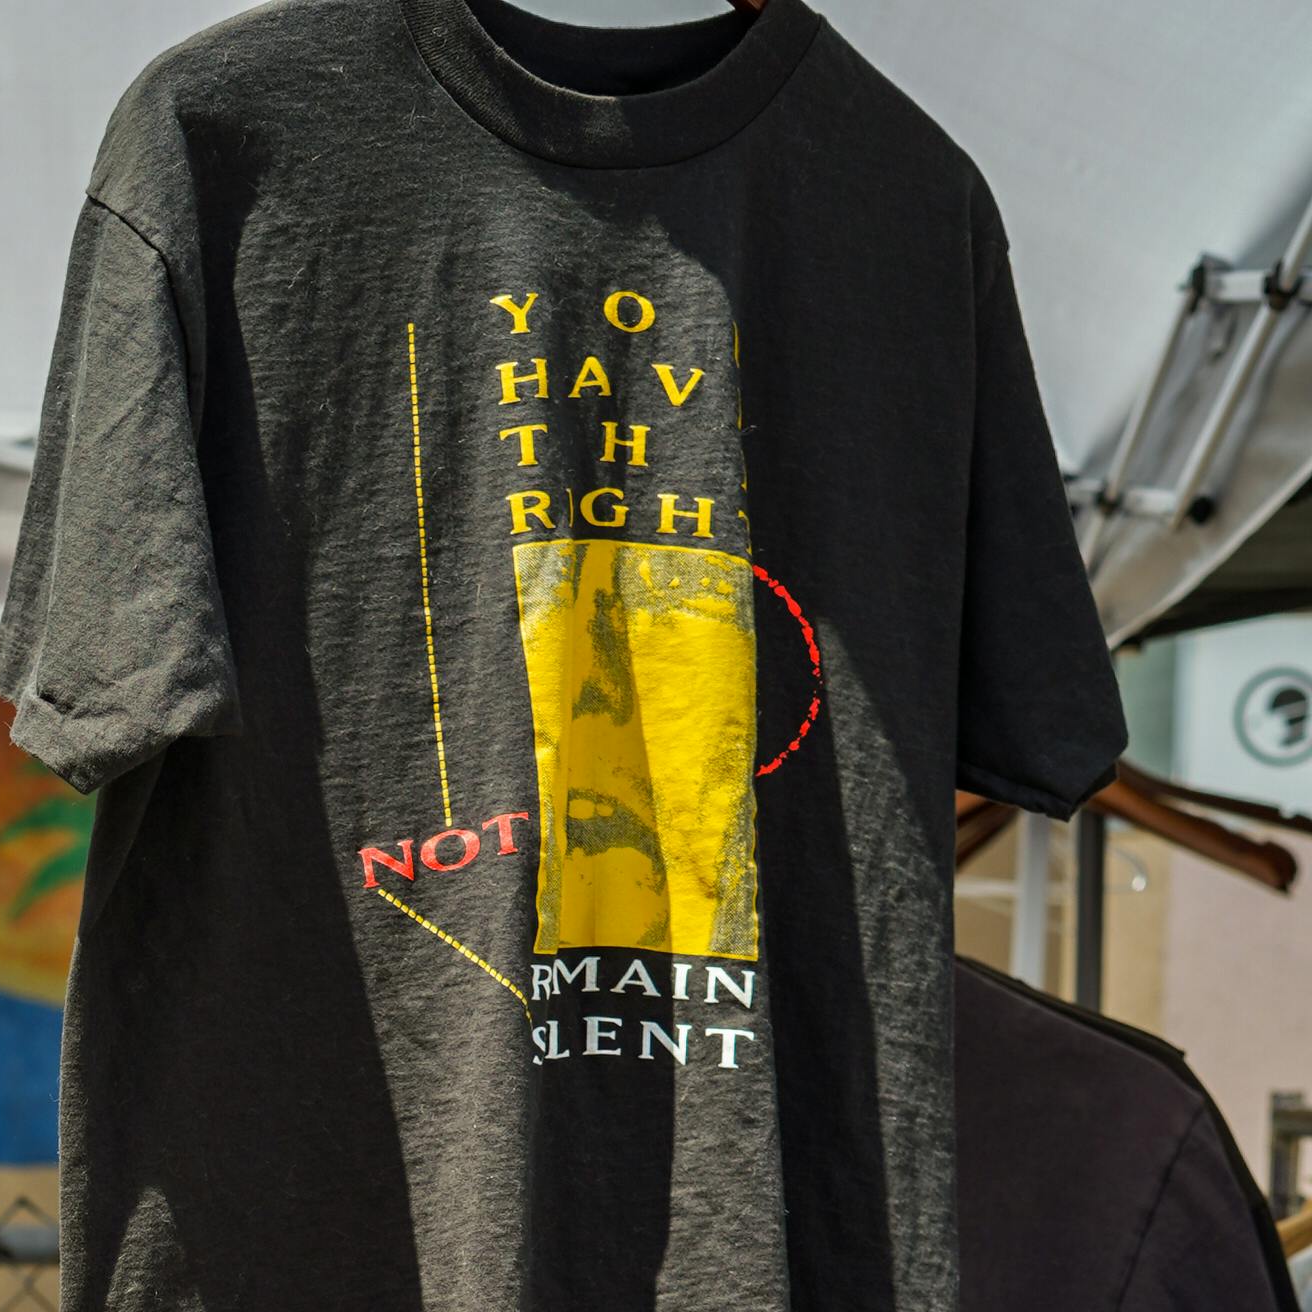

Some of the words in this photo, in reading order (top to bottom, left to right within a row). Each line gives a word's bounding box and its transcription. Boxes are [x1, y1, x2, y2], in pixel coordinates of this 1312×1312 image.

[495, 356, 743, 431] HAV
[357, 811, 529, 889] NOT
[530, 956, 756, 1009] RMAIN
[532, 1015, 756, 1069] SLENT
